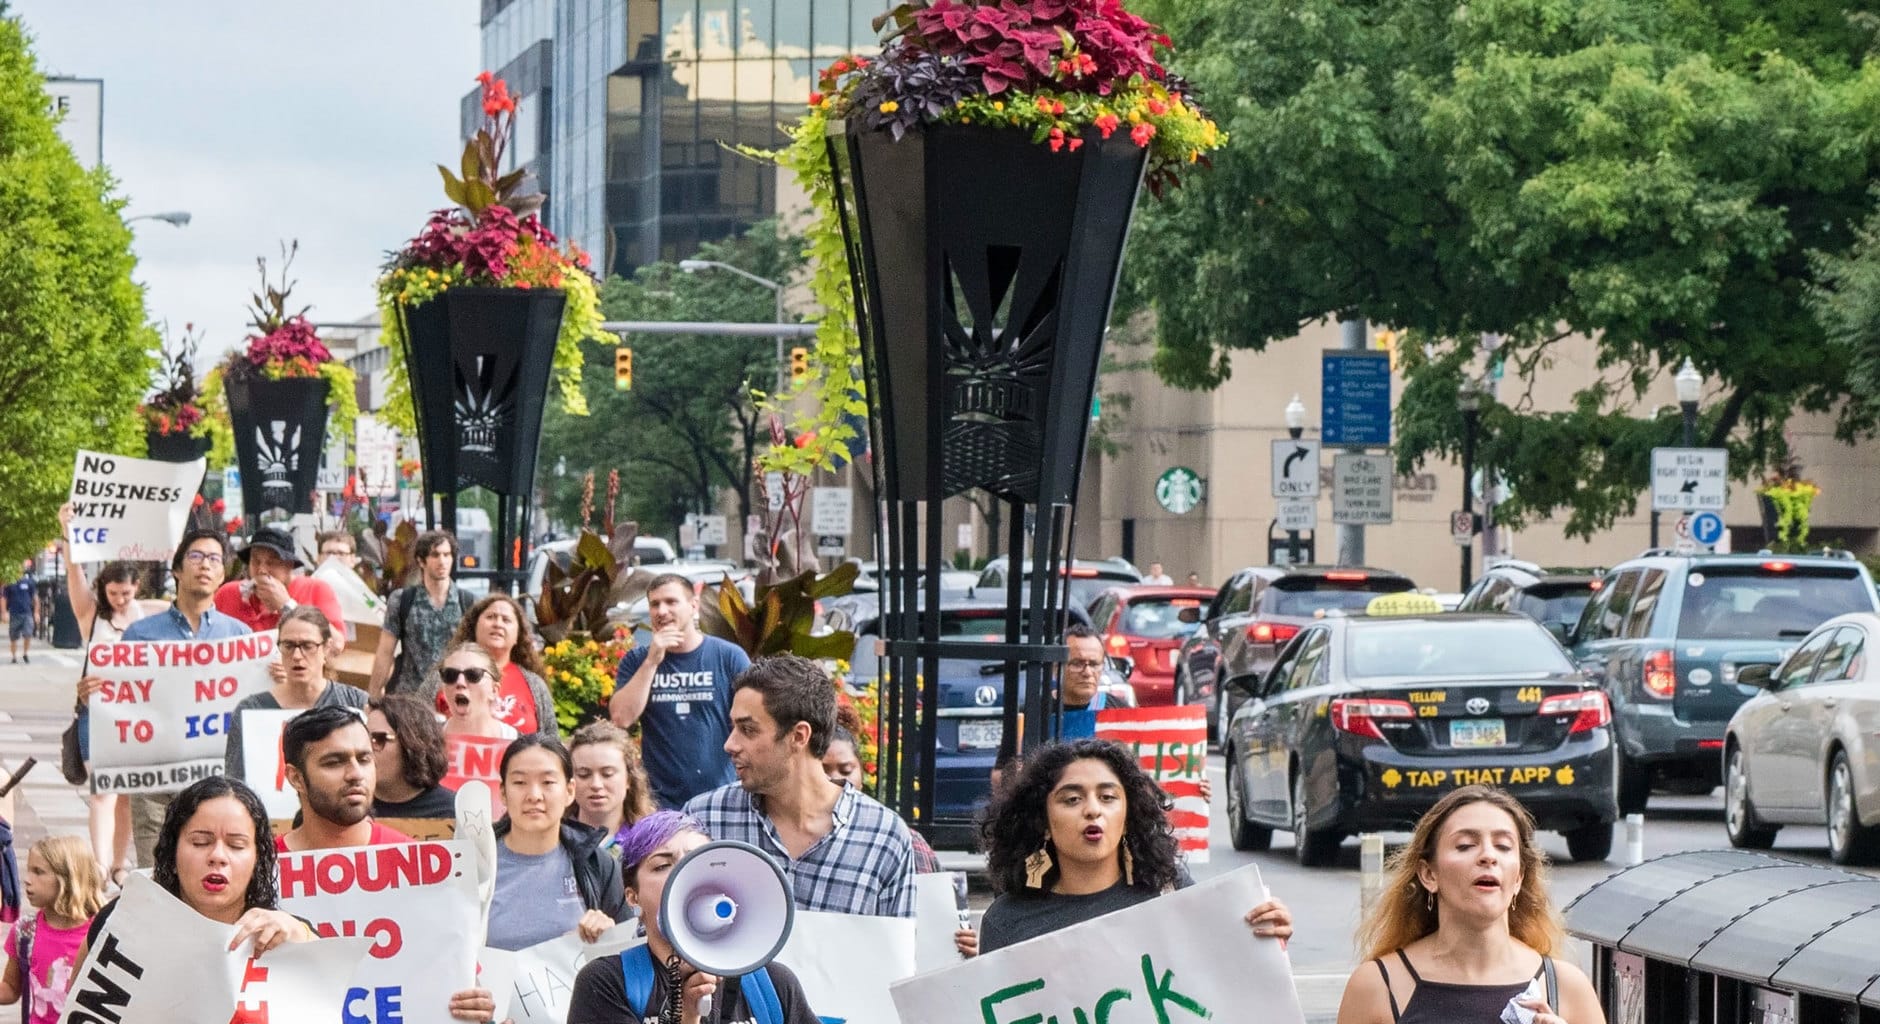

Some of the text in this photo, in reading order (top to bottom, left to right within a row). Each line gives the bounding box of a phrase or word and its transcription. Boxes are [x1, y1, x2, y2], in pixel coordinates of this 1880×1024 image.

[83, 456, 115, 474] NO
[74, 479, 182, 502] BUSINESS
[1280, 481, 1312, 493] ONLY
[73, 502, 126, 519] WITH
[73, 528, 109, 544] ICE
[90, 635, 273, 668] GREYHOUND
[652, 671, 713, 688] JUSTICE
[100, 676, 238, 704] SAY NO
[1408, 691, 1446, 703] YELLOW
[1517, 687, 1542, 703] 441
[1419, 705, 1439, 717] CAB
[115, 720, 154, 743] TO
[97, 764, 224, 789] @ABOLISHIC
[1406, 767, 1551, 787] TAP THAT APP
[279, 843, 462, 899] HOUND:
